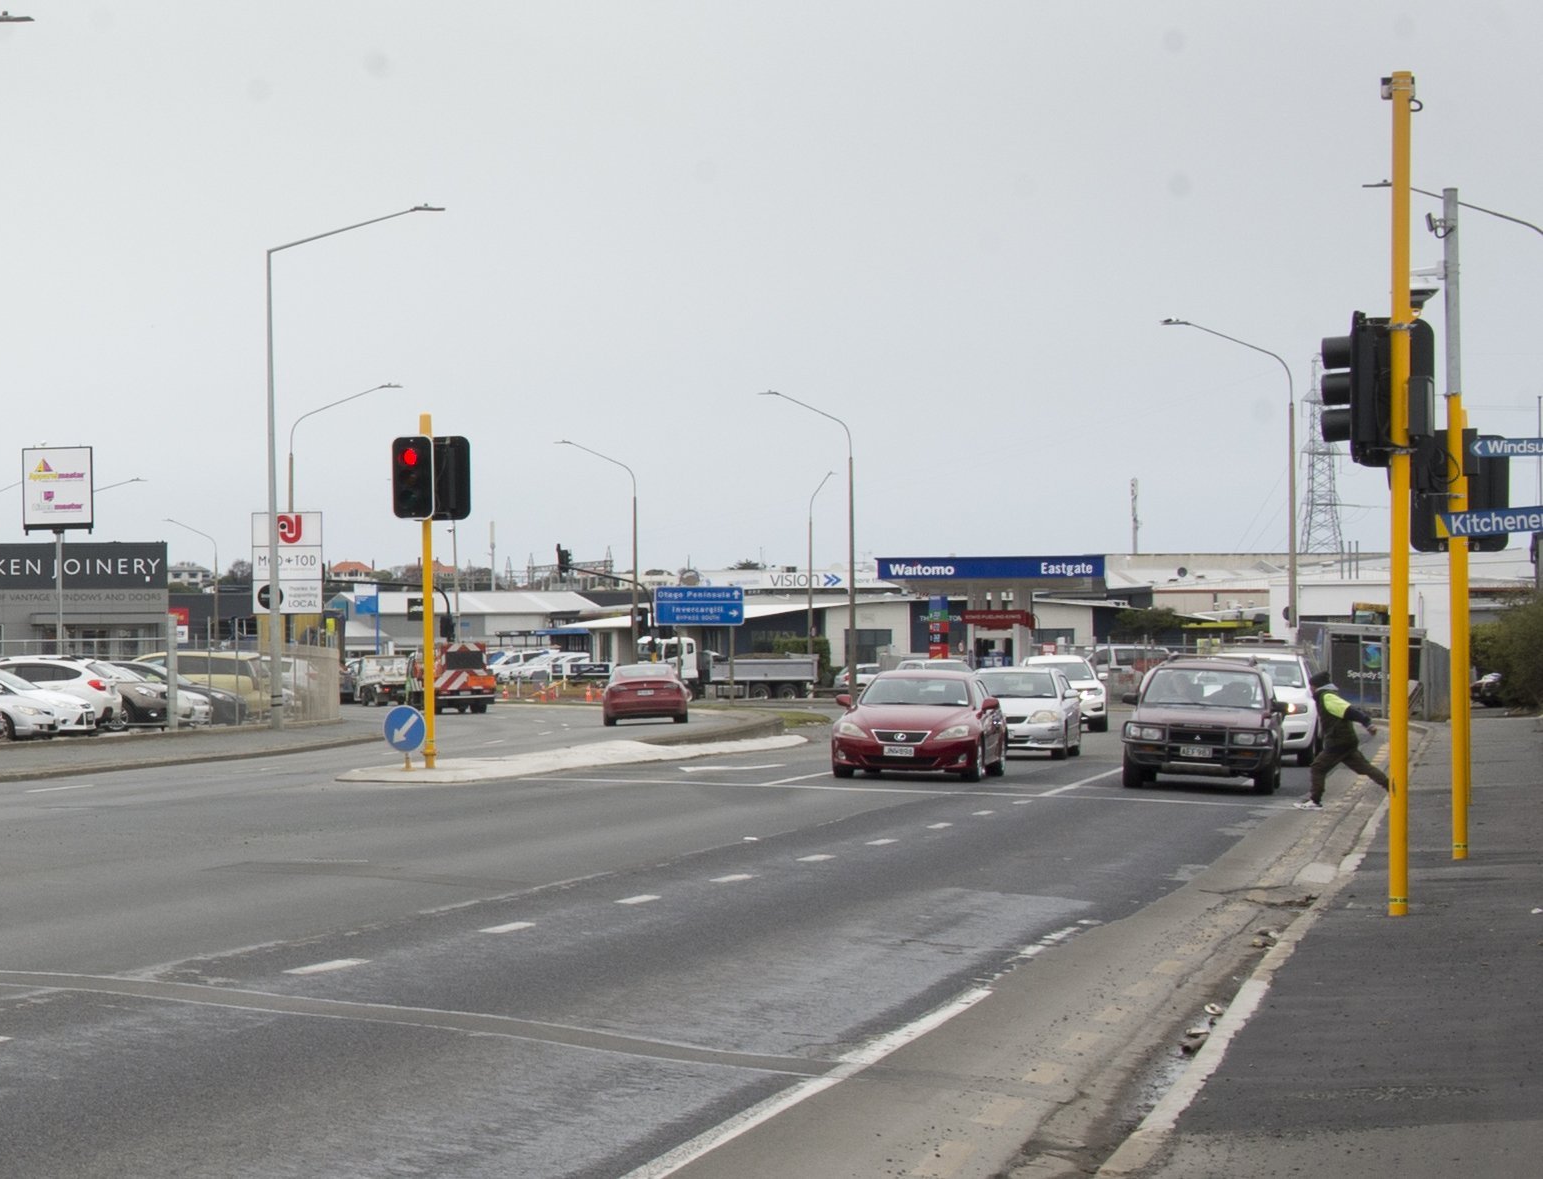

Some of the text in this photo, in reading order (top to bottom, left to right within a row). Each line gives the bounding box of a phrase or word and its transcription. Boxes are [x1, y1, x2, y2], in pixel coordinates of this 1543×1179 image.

[1451, 512, 1543, 534] Kitchene
[258, 555, 283, 566] MD
[295, 555, 316, 567] TOD
[51, 558, 161, 579] JOINERY
[889, 563, 955, 576] Waitomo
[1041, 562, 1093, 576] Eastgate
[9, 593, 51, 602] VANTAGE
[53, 593, 102, 601] INDOWS
[105, 592, 127, 601] AND
[128, 592, 162, 601] DOORS
[658, 590, 731, 599] Otago Peninsula
[288, 600, 317, 608] LOCAL
[672, 606, 723, 614] Invercargill
[1347, 670, 1377, 680] Speedy
